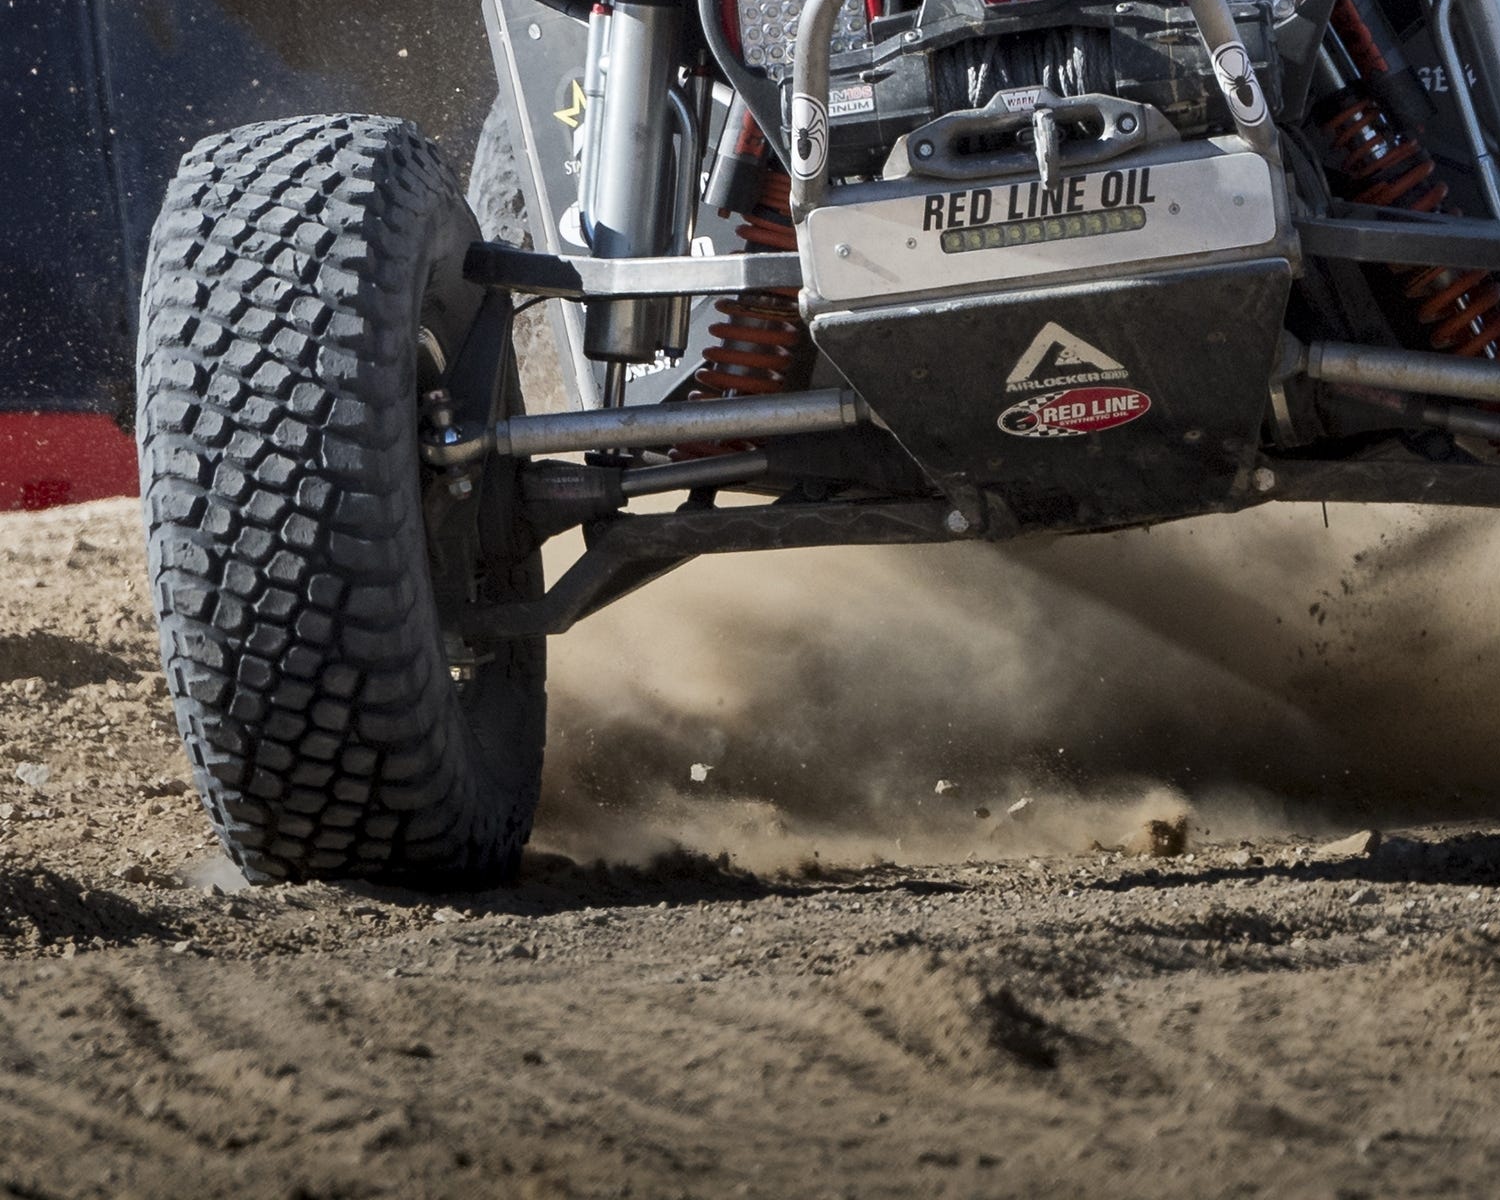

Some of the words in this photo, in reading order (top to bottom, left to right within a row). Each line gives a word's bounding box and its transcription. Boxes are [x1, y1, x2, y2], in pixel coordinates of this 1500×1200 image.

[1007, 95, 1035, 108] WARN
[923, 188, 992, 232] RED
[1007, 175, 1087, 221] LINE
[1100, 167, 1156, 208] OIL
[1043, 402, 1087, 424] RED
[1092, 394, 1142, 416] LINE
[1058, 412, 1111, 427] SYNTHETIC
[1113, 411, 1129, 419] OIL
